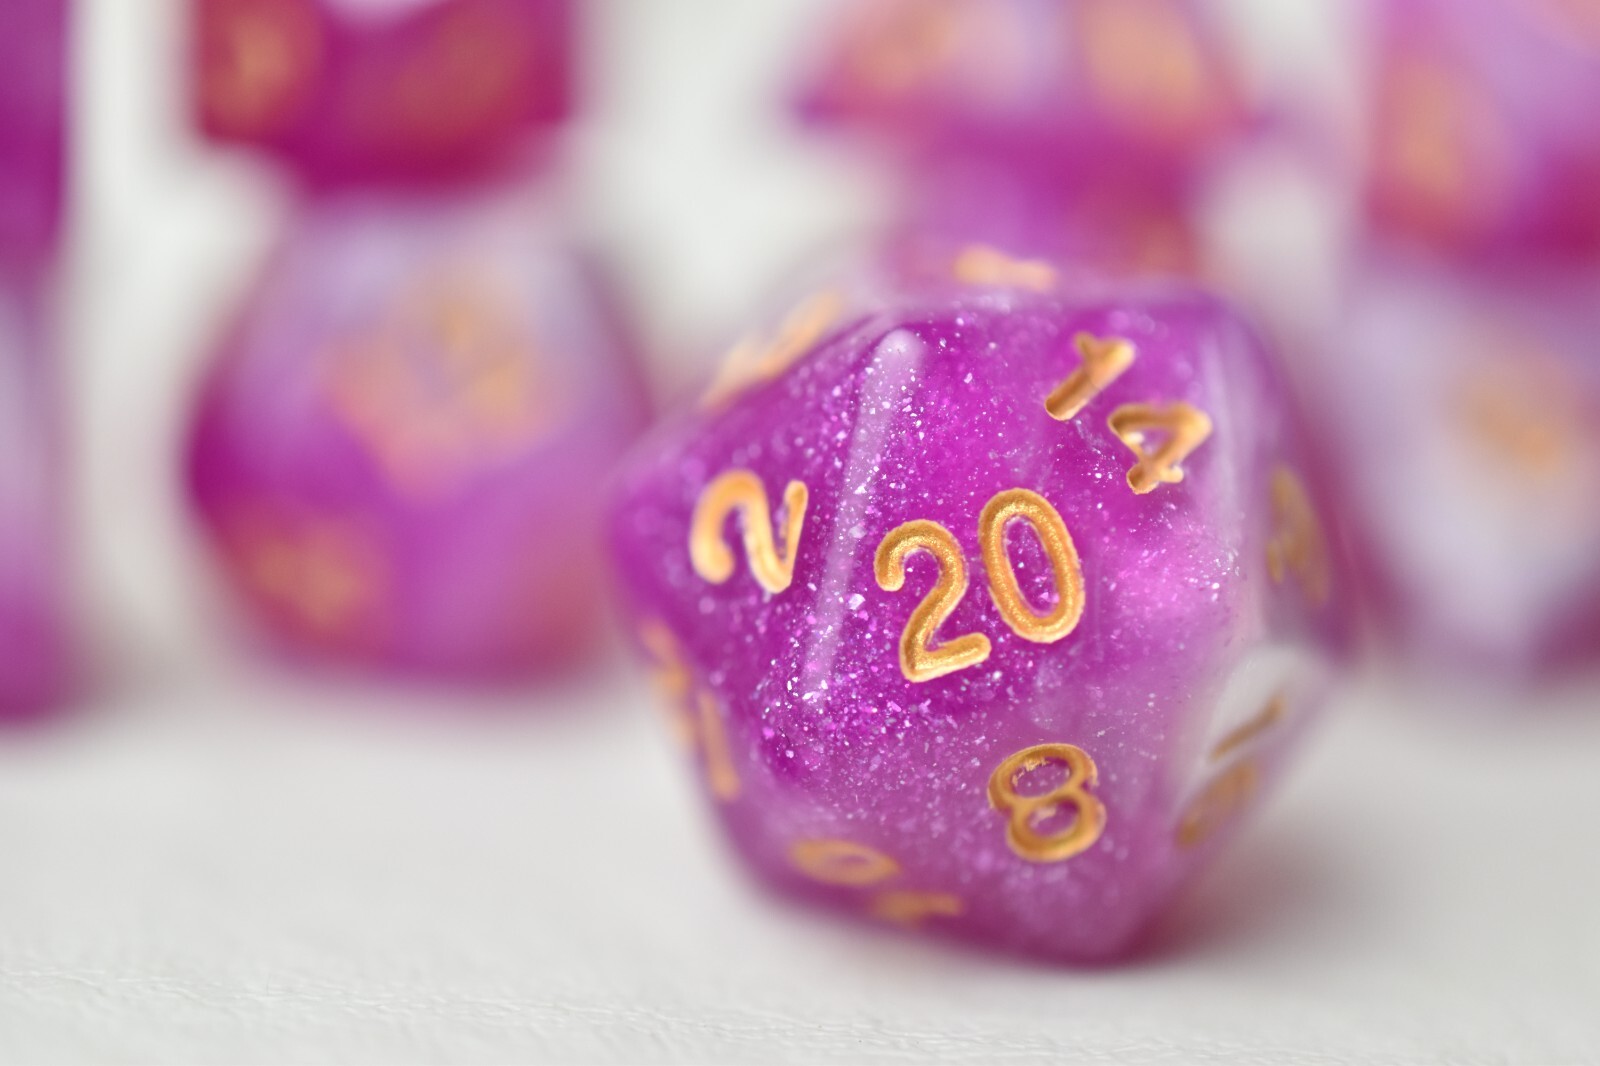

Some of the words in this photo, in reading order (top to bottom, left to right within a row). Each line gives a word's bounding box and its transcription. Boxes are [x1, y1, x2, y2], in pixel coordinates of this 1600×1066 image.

[1045, 333, 1212, 494] 14
[690, 469, 808, 593] 2
[874, 488, 1086, 683] 20
[987, 743, 1106, 862] 8
